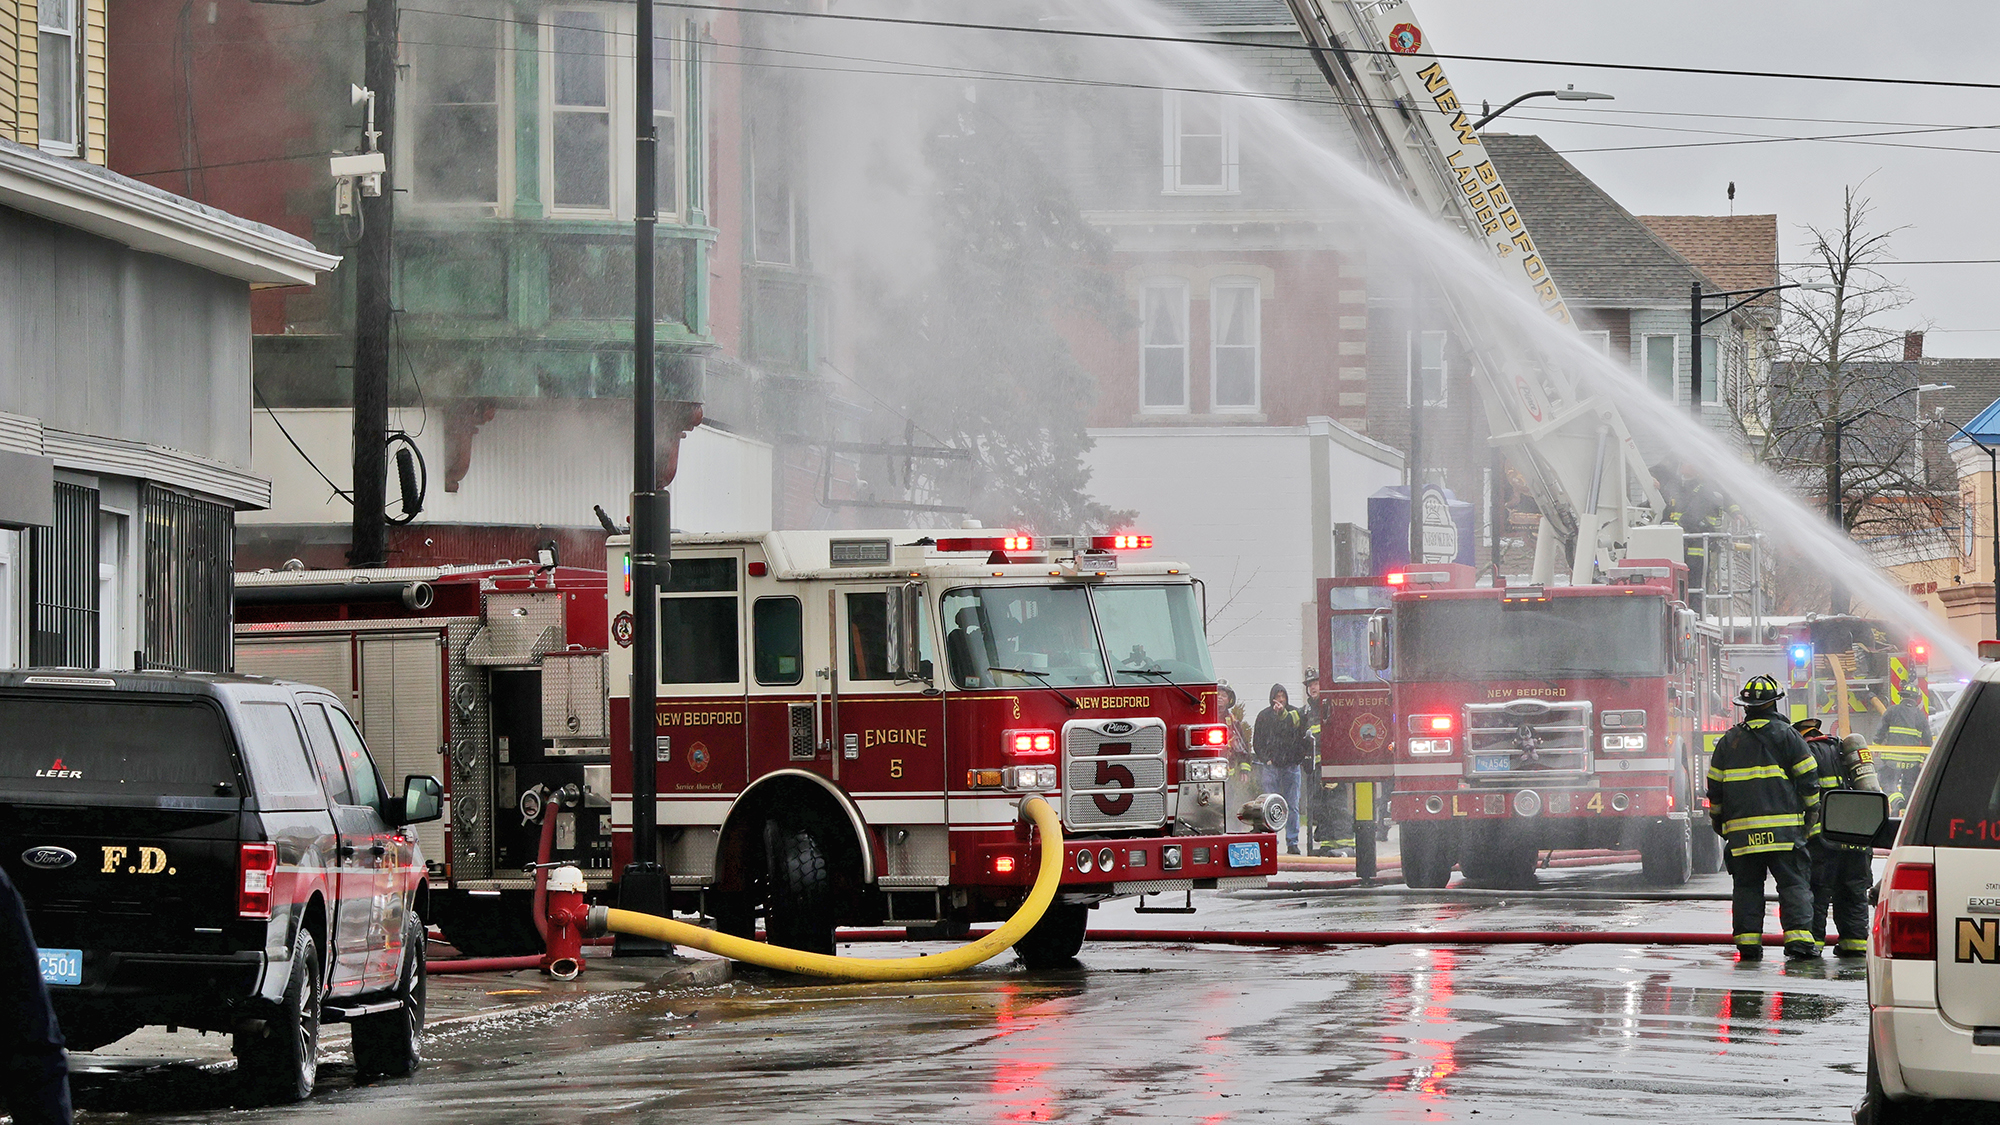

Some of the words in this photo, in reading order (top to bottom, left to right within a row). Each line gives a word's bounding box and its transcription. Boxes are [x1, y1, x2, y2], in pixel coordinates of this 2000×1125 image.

[1416, 62, 1480, 147] NEW
[1474, 160, 1570, 325] BEDFORD
[1446, 150, 1501, 237] LADDER
[1496, 242, 1513, 258] 4
[1487, 689, 1512, 698] NEW
[1516, 688, 1566, 697] BEDFORD
[1076, 697, 1100, 709] NEW
[1101, 696, 1150, 709] BEDFORD
[1331, 698, 1355, 706] NEW
[656, 713, 682, 726] NEW
[683, 711, 742, 726] BEDFORD
[1107, 722, 1130, 734] Pierce
[865, 729, 929, 748] ENGINE
[890, 759, 903, 778] 5
[1489, 758, 1509, 768] A545
[35, 769, 82, 779] LEER
[1090, 742, 1135, 816] 5
[1452, 795, 1468, 816] L
[1586, 792, 1605, 814] 4
[1748, 831, 1775, 845] NBFD
[34, 850, 64, 863] Ford
[101, 846, 176, 875] F.D.
[1240, 847, 1260, 860] 9560
[1955, 917, 2000, 963] N
[39, 957, 77, 976] C501
